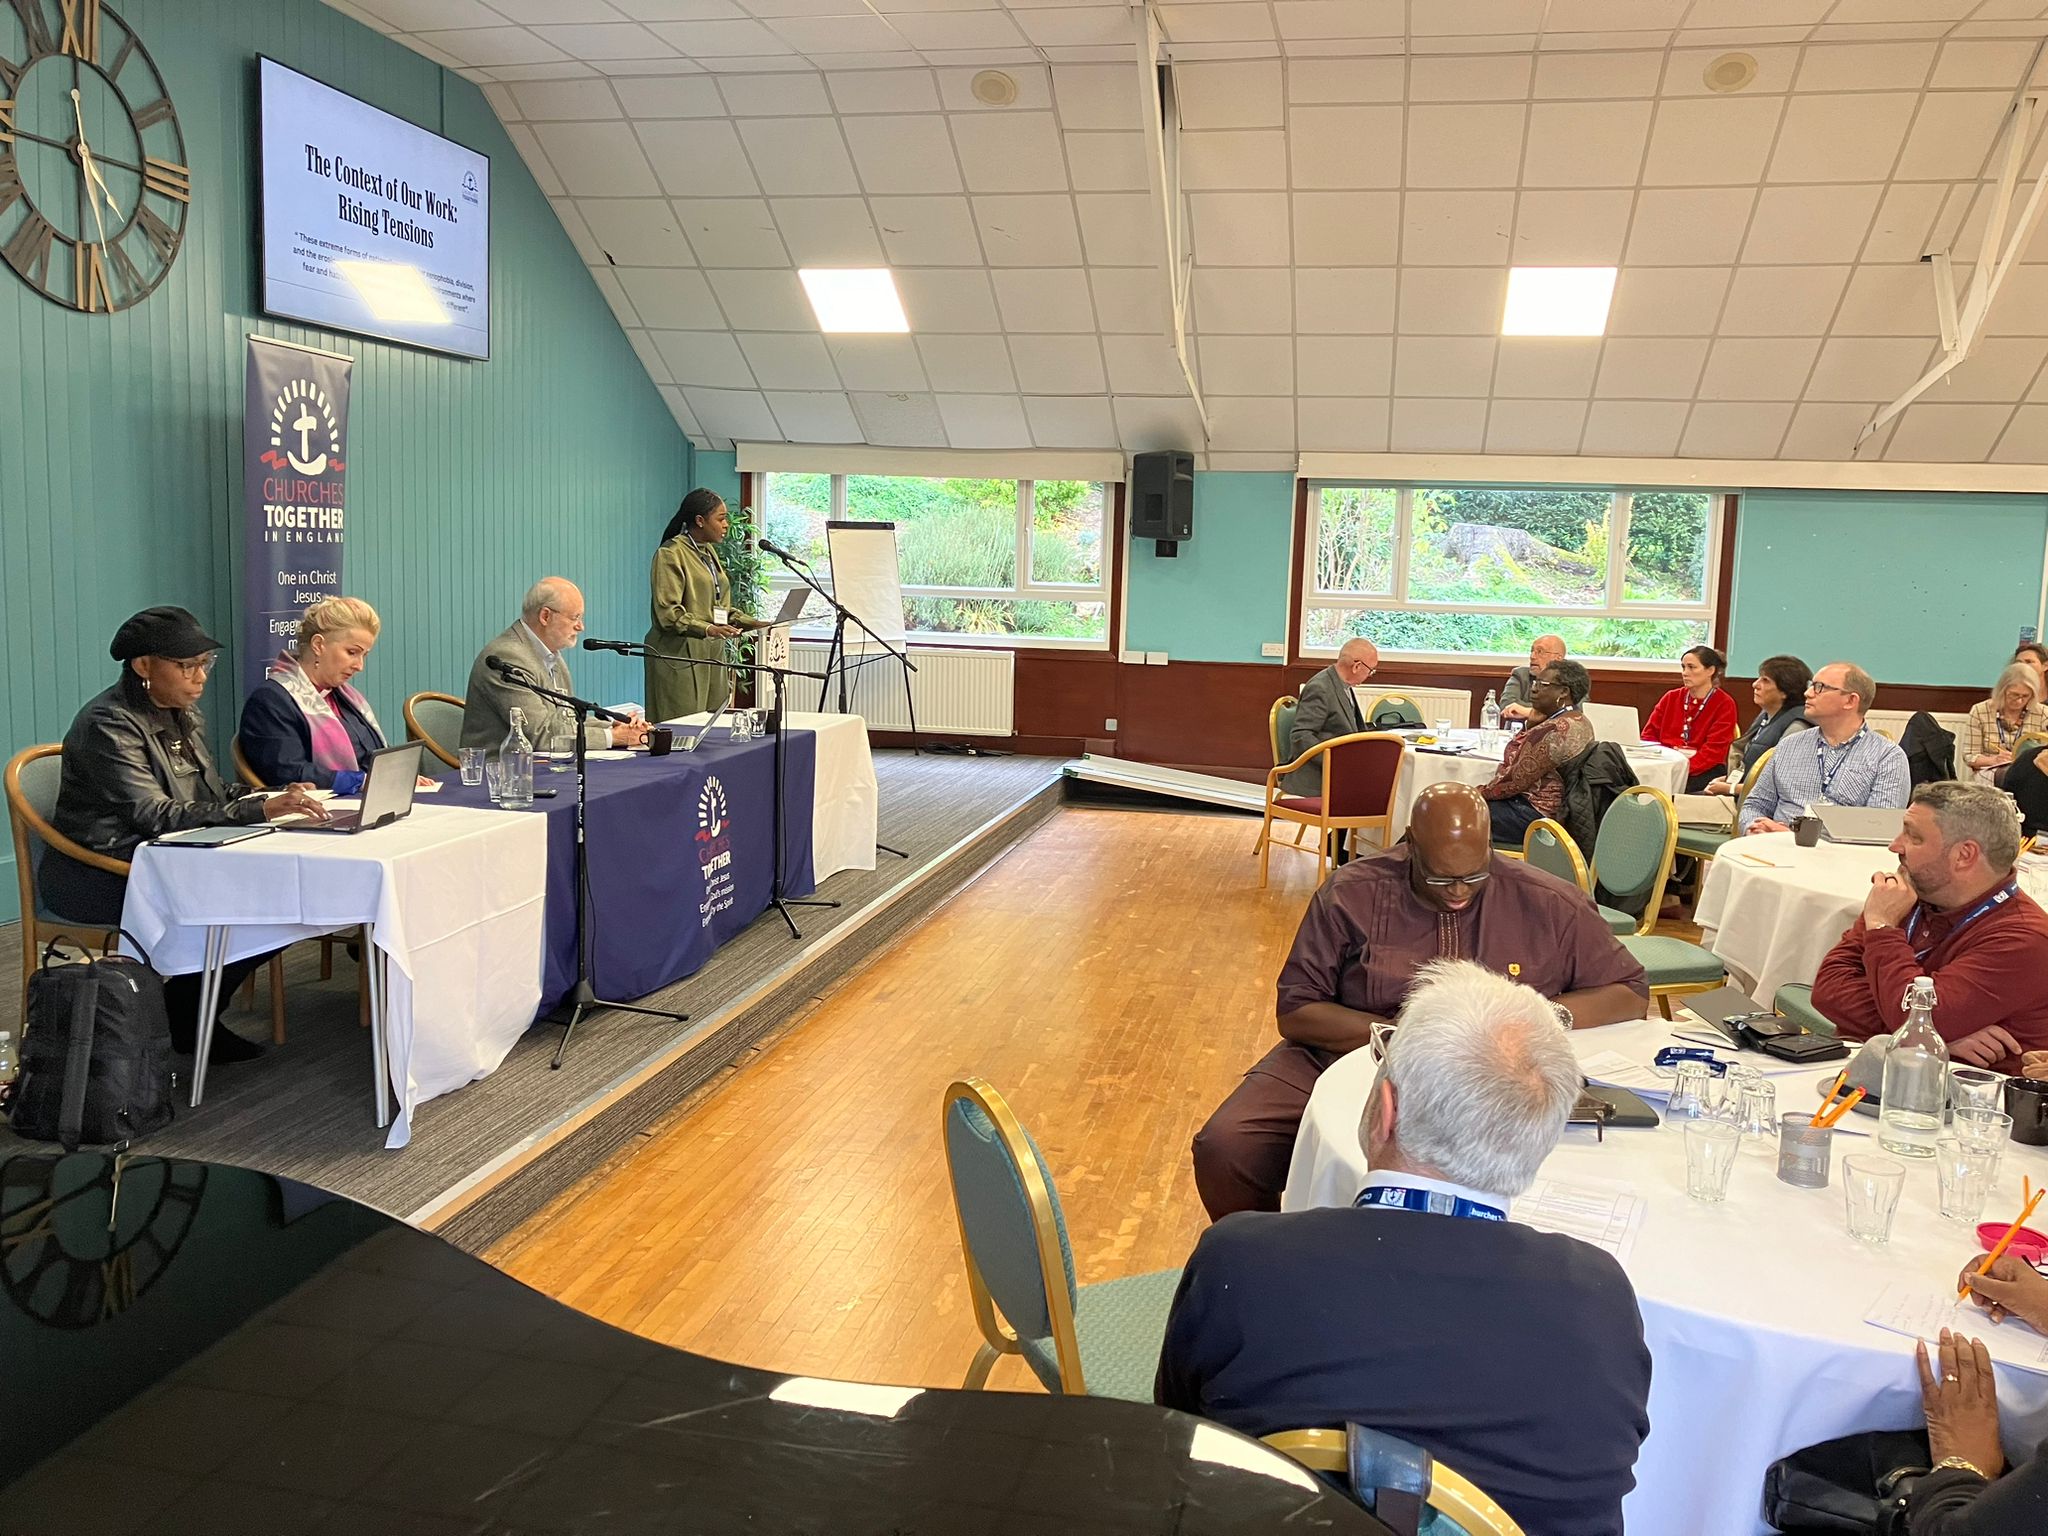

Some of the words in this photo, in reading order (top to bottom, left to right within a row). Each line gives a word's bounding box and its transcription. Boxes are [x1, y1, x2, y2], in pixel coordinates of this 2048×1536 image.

[305, 144, 331, 178] The
[335, 155, 383, 197] Context
[386, 178, 398, 202] of
[401, 181, 422, 211] Our
[425, 189, 458, 224] Work:
[338, 193, 379, 236] Rising
[382, 209, 434, 249] Tensions
[299, 232, 320, 246] These
[319, 239, 343, 253] extreme
[293, 246, 305, 256] and
[306, 249, 316, 260] the
[303, 261, 315, 273] fear
[316, 267, 328, 277] and
[263, 477, 344, 505] CHURCHES
[263, 505, 344, 530] TOGETHER
[265, 531, 278, 542] IN
[277, 570, 297, 586] One
[298, 570, 308, 585] in
[309, 570, 337, 585] Christ
[293, 590, 322, 604] Jesus
